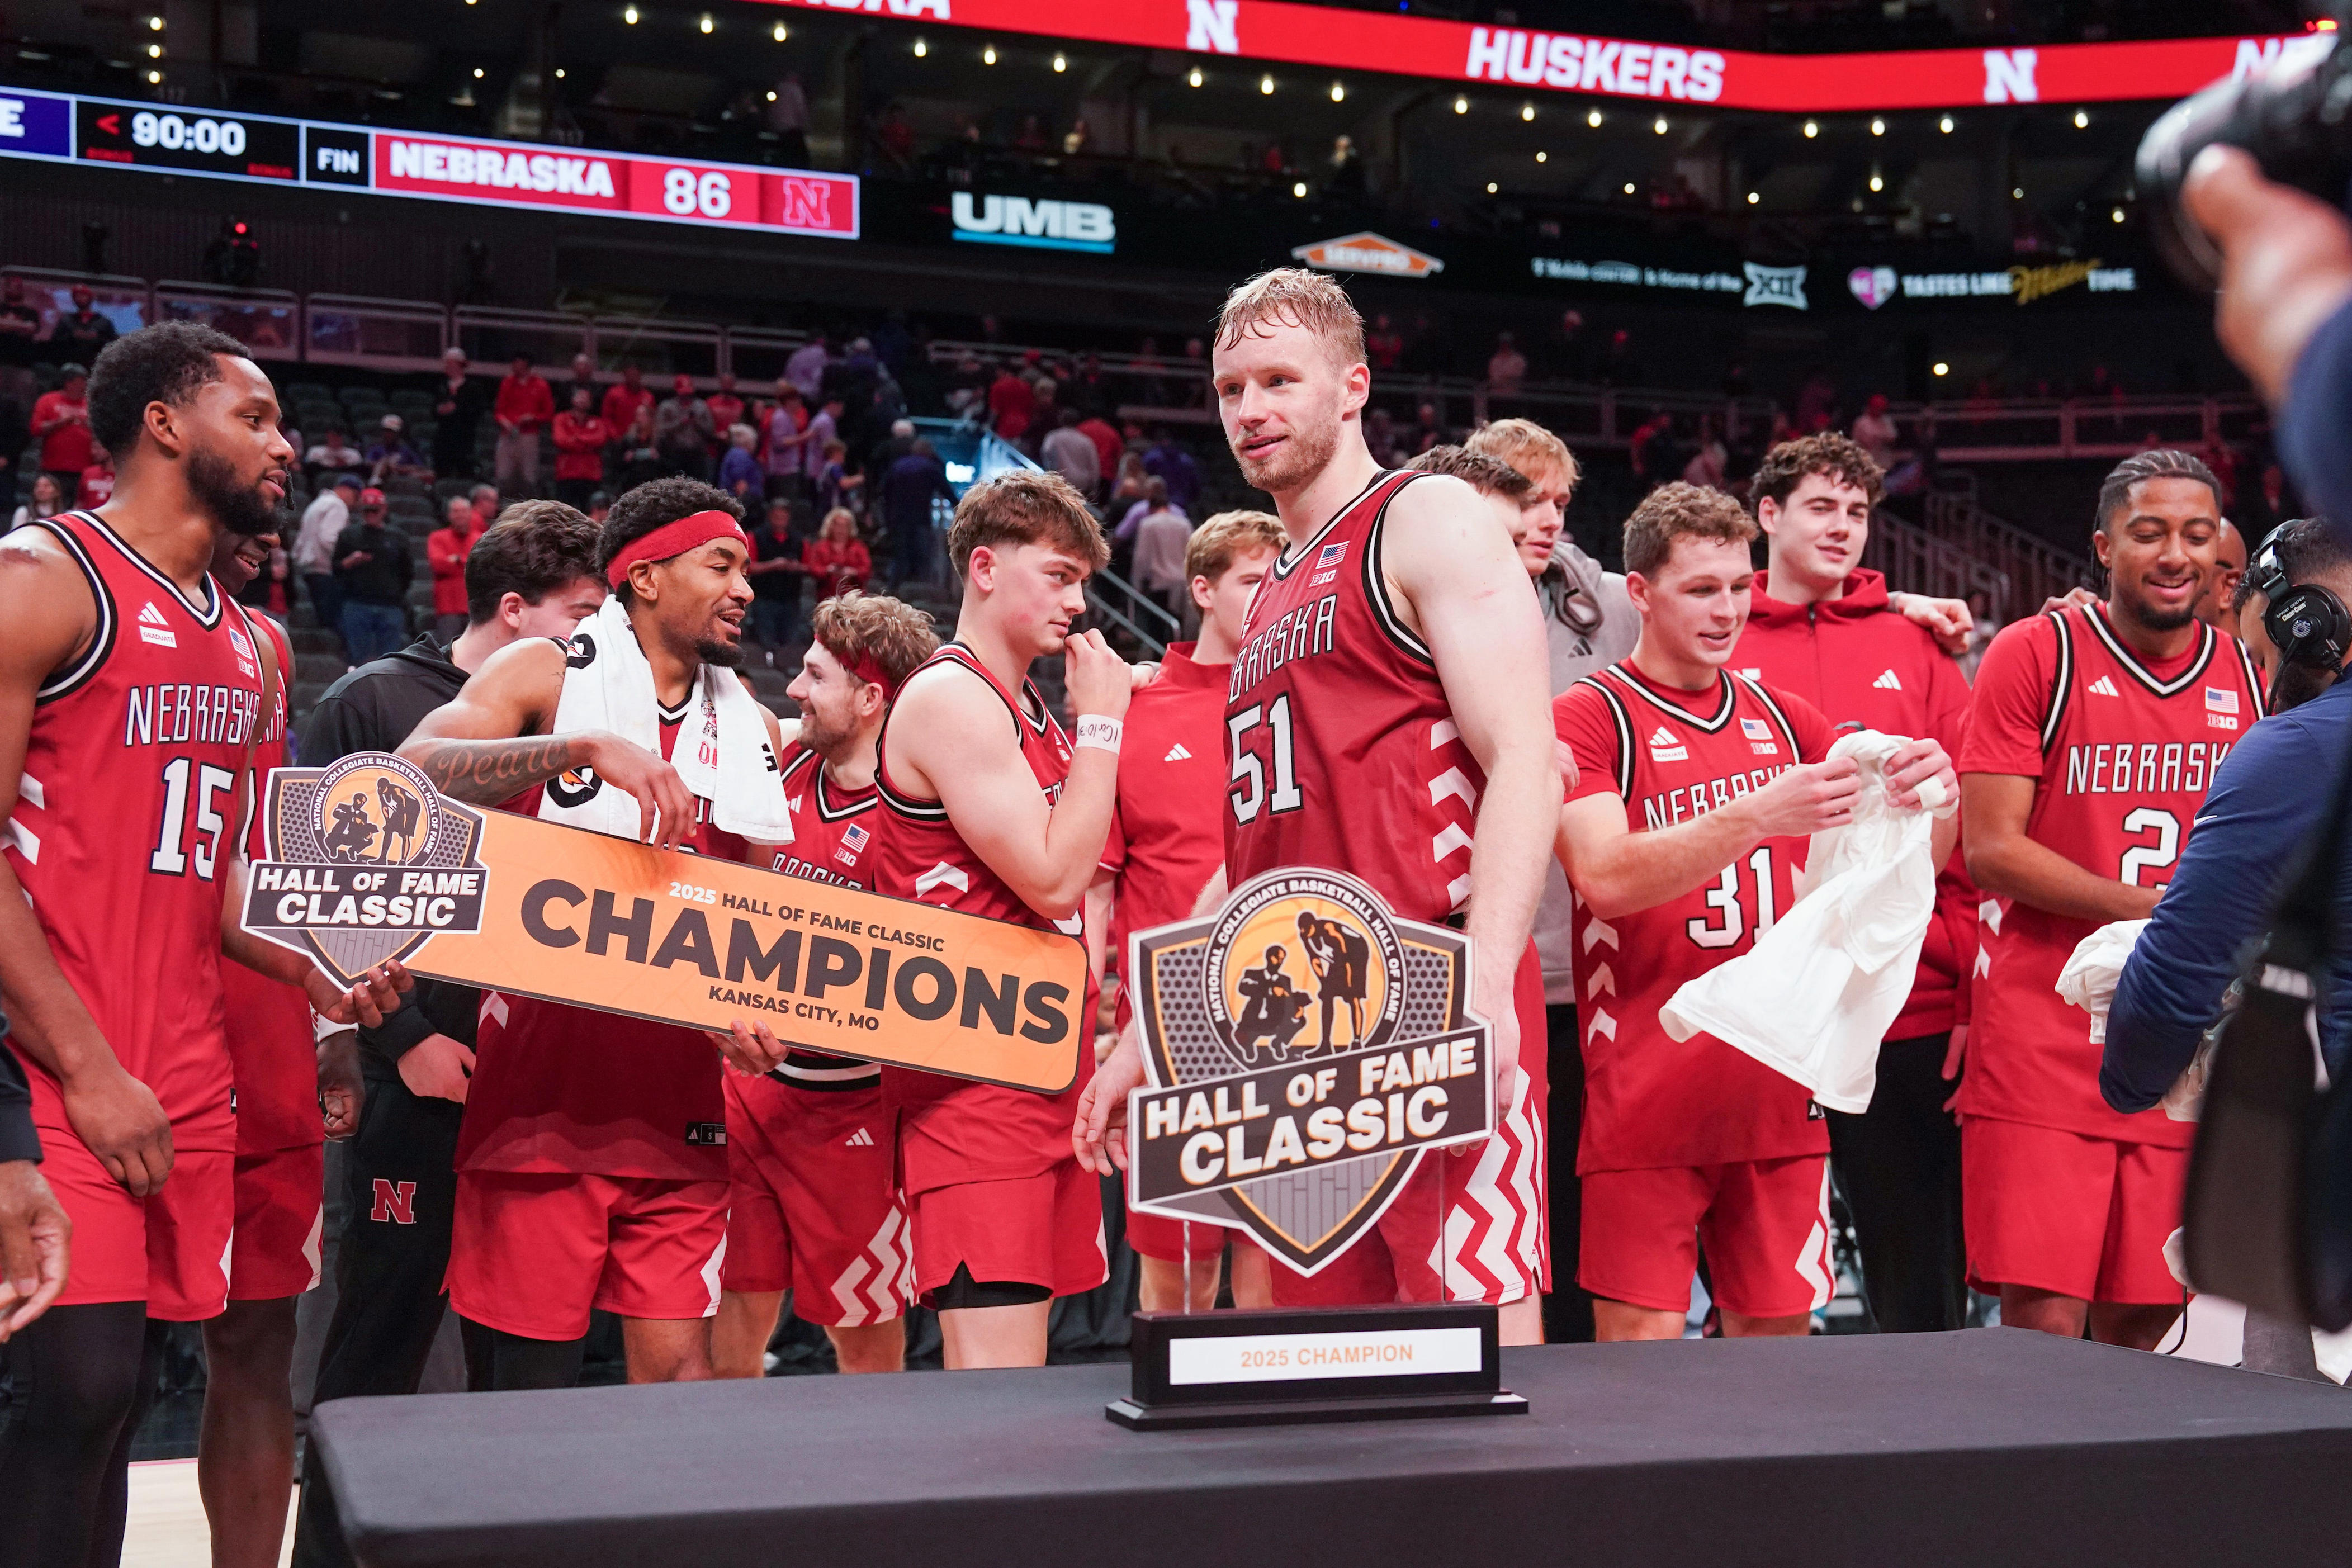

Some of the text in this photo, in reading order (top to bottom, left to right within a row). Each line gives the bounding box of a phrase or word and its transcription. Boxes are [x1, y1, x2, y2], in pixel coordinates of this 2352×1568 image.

[1186, 0, 1239, 55] N
[1465, 26, 1726, 102] HUSKERS
[1983, 49, 2037, 103] N
[132, 112, 247, 157] 90:00
[317, 146, 359, 174] FIN
[390, 140, 615, 198] NEBRASKA
[663, 168, 732, 219] 86
[783, 178, 831, 228] N
[952, 191, 1115, 242] UMB
[2289, 596, 2305, 608] CENTER
[143, 631, 174, 643] GRADUATE
[1228, 594, 1337, 705] BRASKA
[1226, 692, 1303, 827] 51
[2066, 742, 2231, 794] NEBRASK
[149, 756, 236, 883] 15
[313, 757, 439, 855] NATIONAL COLLEGIATE BASKETBALL HALL OF FAME
[2119, 807, 2180, 890] 2
[258, 868, 480, 896] HALL OF FAME
[1686, 845, 1778, 950] 31
[276, 893, 456, 927] CLASSIC
[669, 881, 945, 952] 2025 HALL OF FAME CLASSIC
[520, 879, 1071, 1044] CHAMPIONS
[1207, 879, 1402, 1023] NATIONAL COLLEGIATE BASKETBALL HALL OF FAME
[708, 985, 880, 1031] KANSAS CITY, MO
[1145, 1037, 1478, 1140] HALL OF FAME
[1180, 1086, 1450, 1187] CLASSIC
[370, 1177, 418, 1225] N
[1240, 1344, 1413, 1368] 2025 CHAMPION
